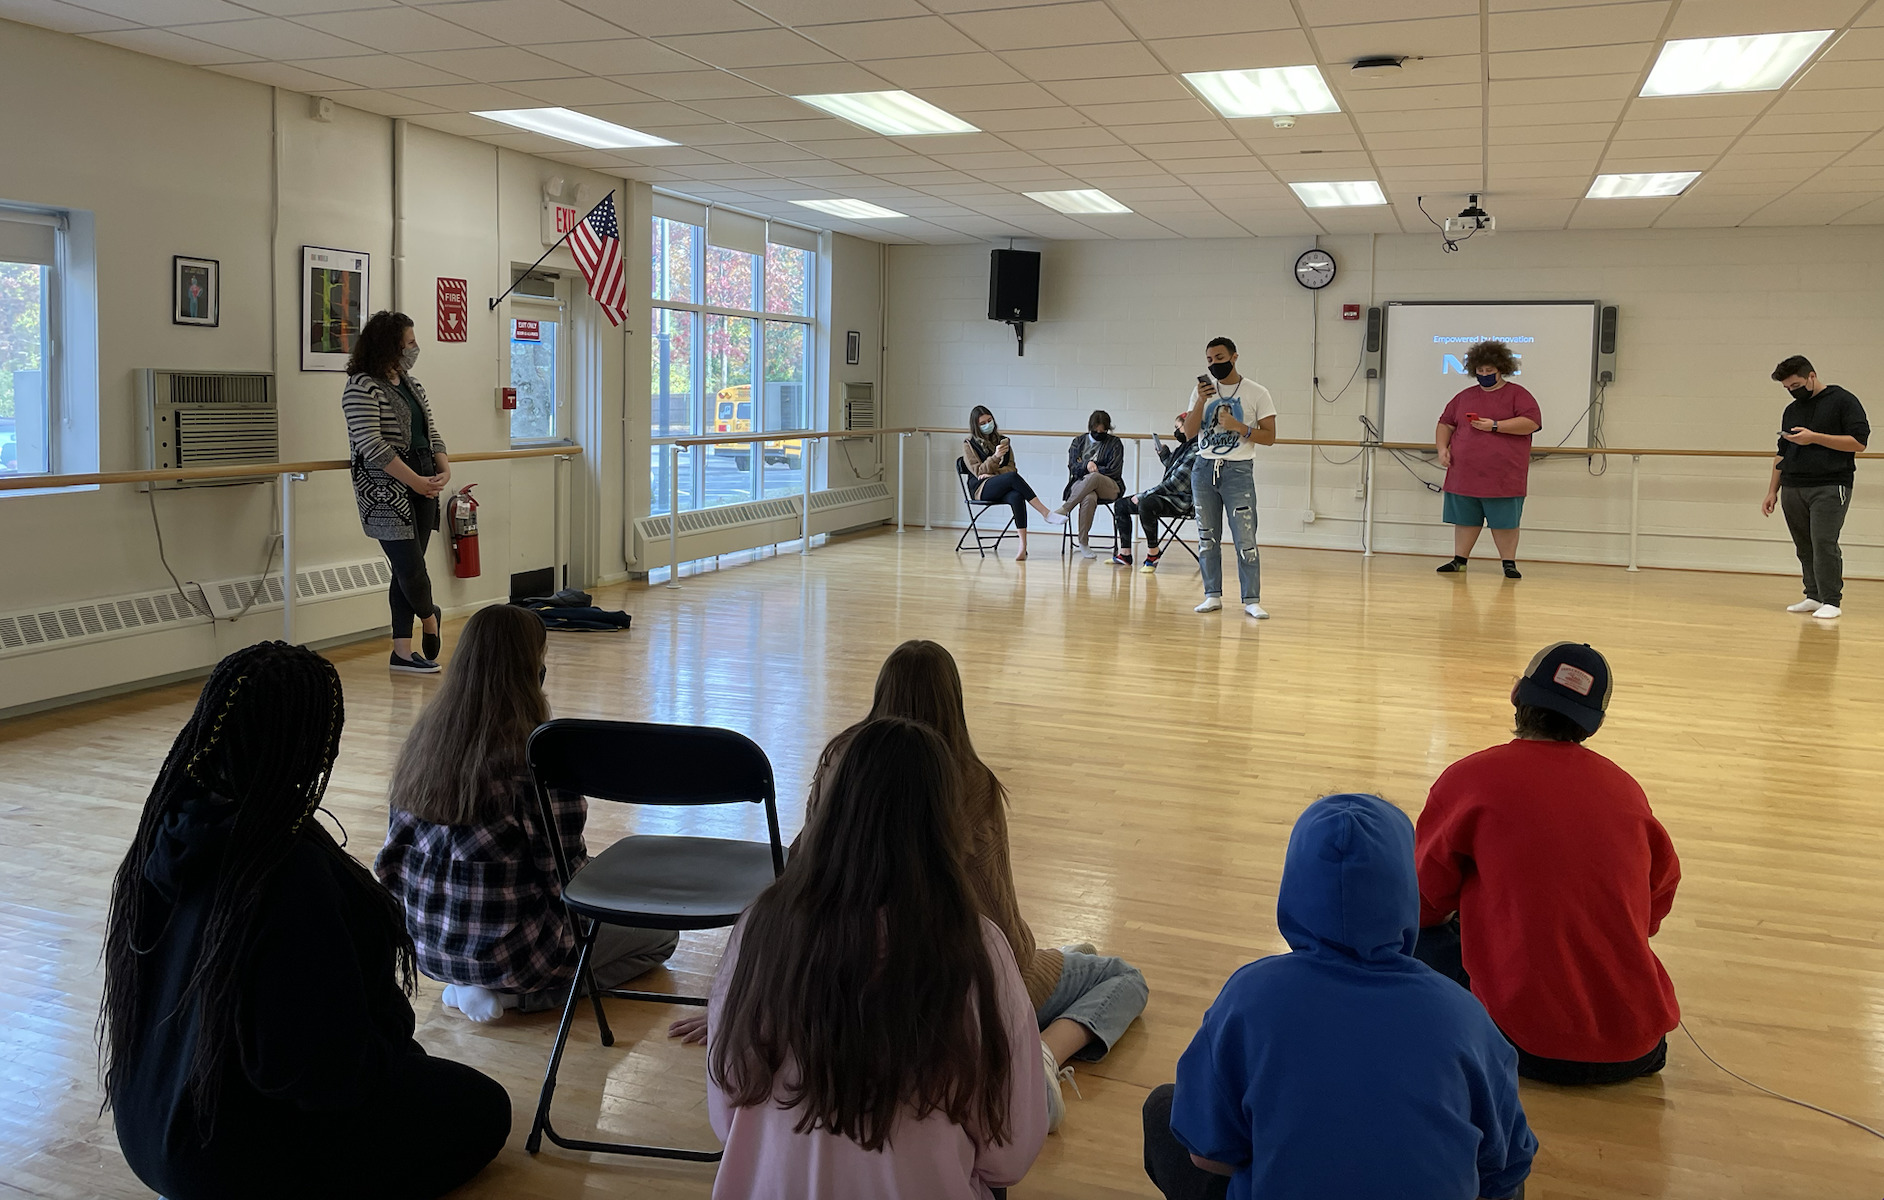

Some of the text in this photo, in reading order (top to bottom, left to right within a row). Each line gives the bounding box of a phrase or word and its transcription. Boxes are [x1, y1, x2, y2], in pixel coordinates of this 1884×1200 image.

[556, 206, 576, 233] EXIT
[445, 292, 461, 303] FIRE
[1433, 335, 1479, 345] Empowered
[1492, 335, 1535, 343] Innovation
